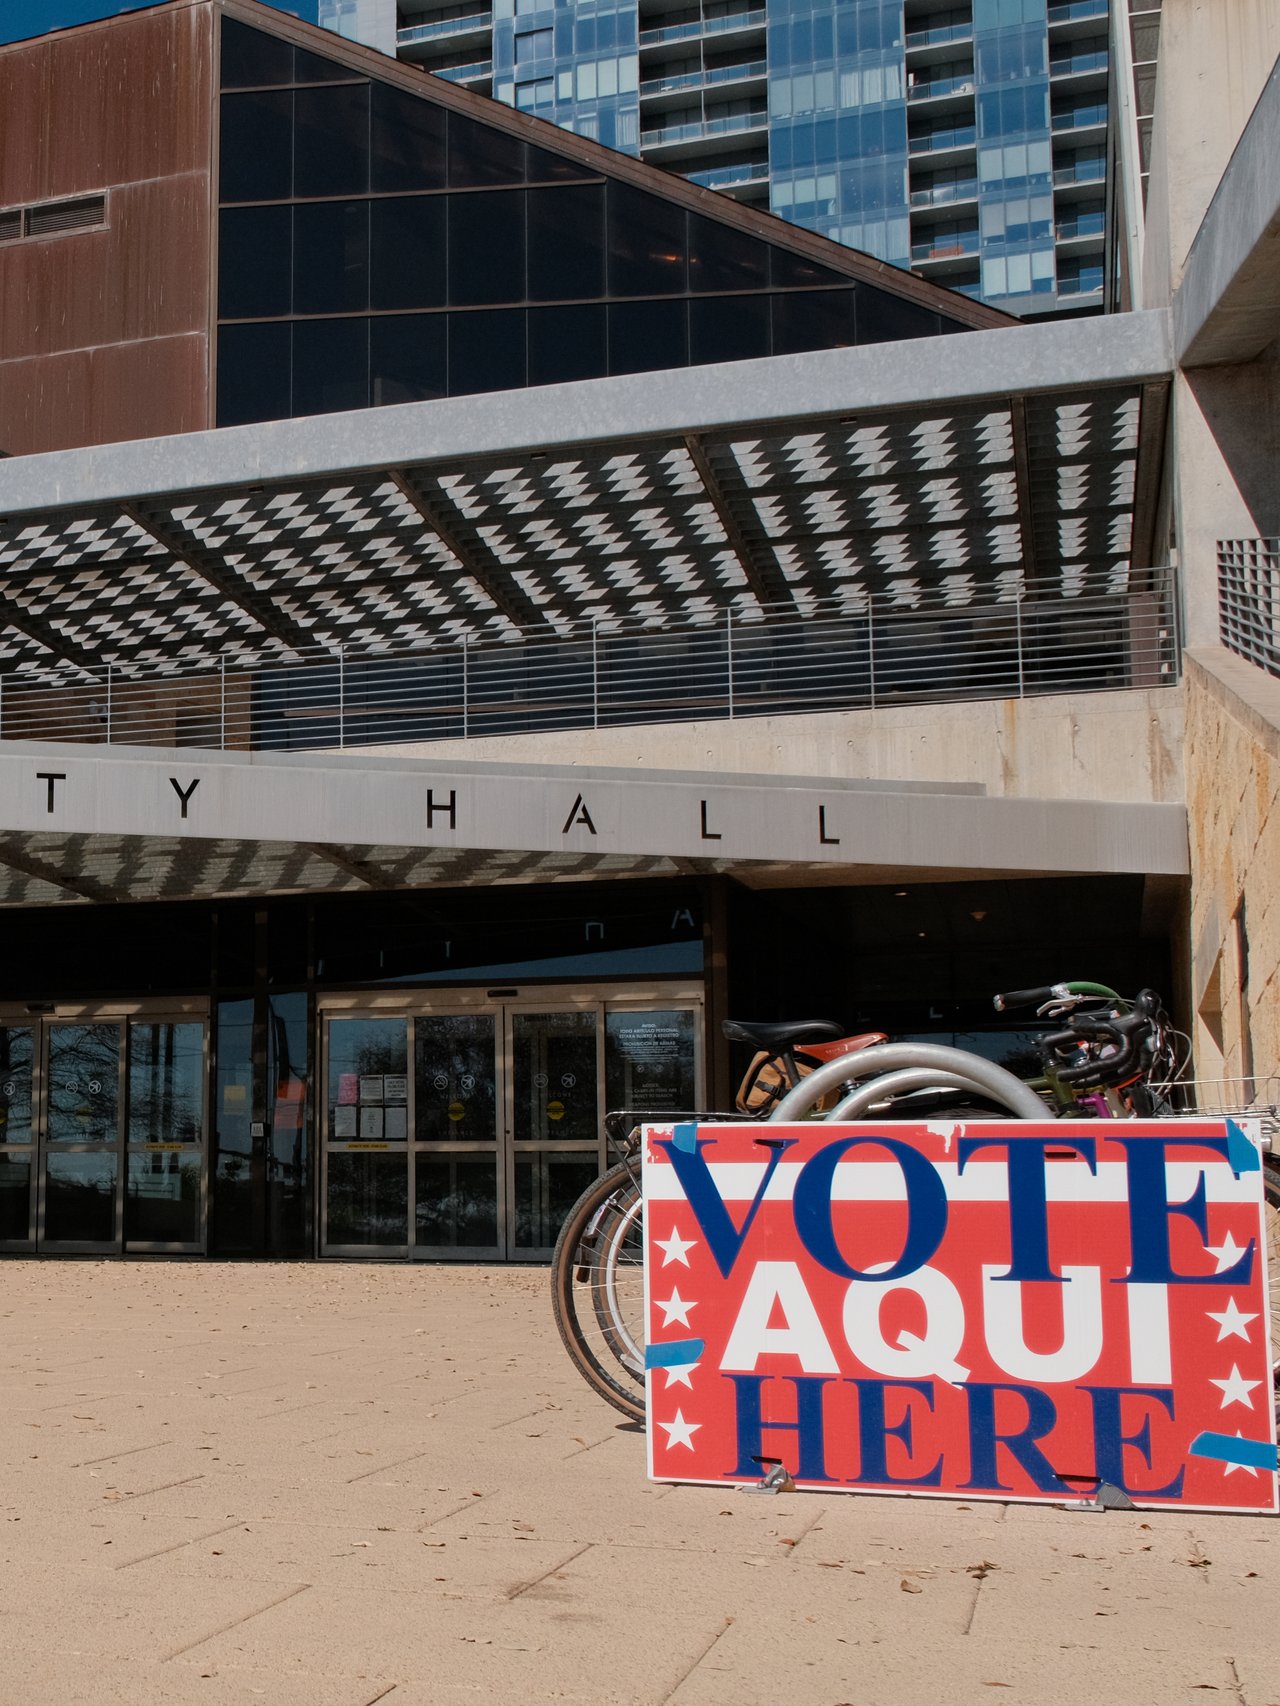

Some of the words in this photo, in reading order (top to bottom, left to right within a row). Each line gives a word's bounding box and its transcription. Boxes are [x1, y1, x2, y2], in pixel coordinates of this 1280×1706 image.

[426, 789, 841, 845] HALL
[652, 1136, 1256, 1285] VOTE
[718, 1260, 1173, 1390] AQUI
[721, 1374, 1187, 1499] HERE
